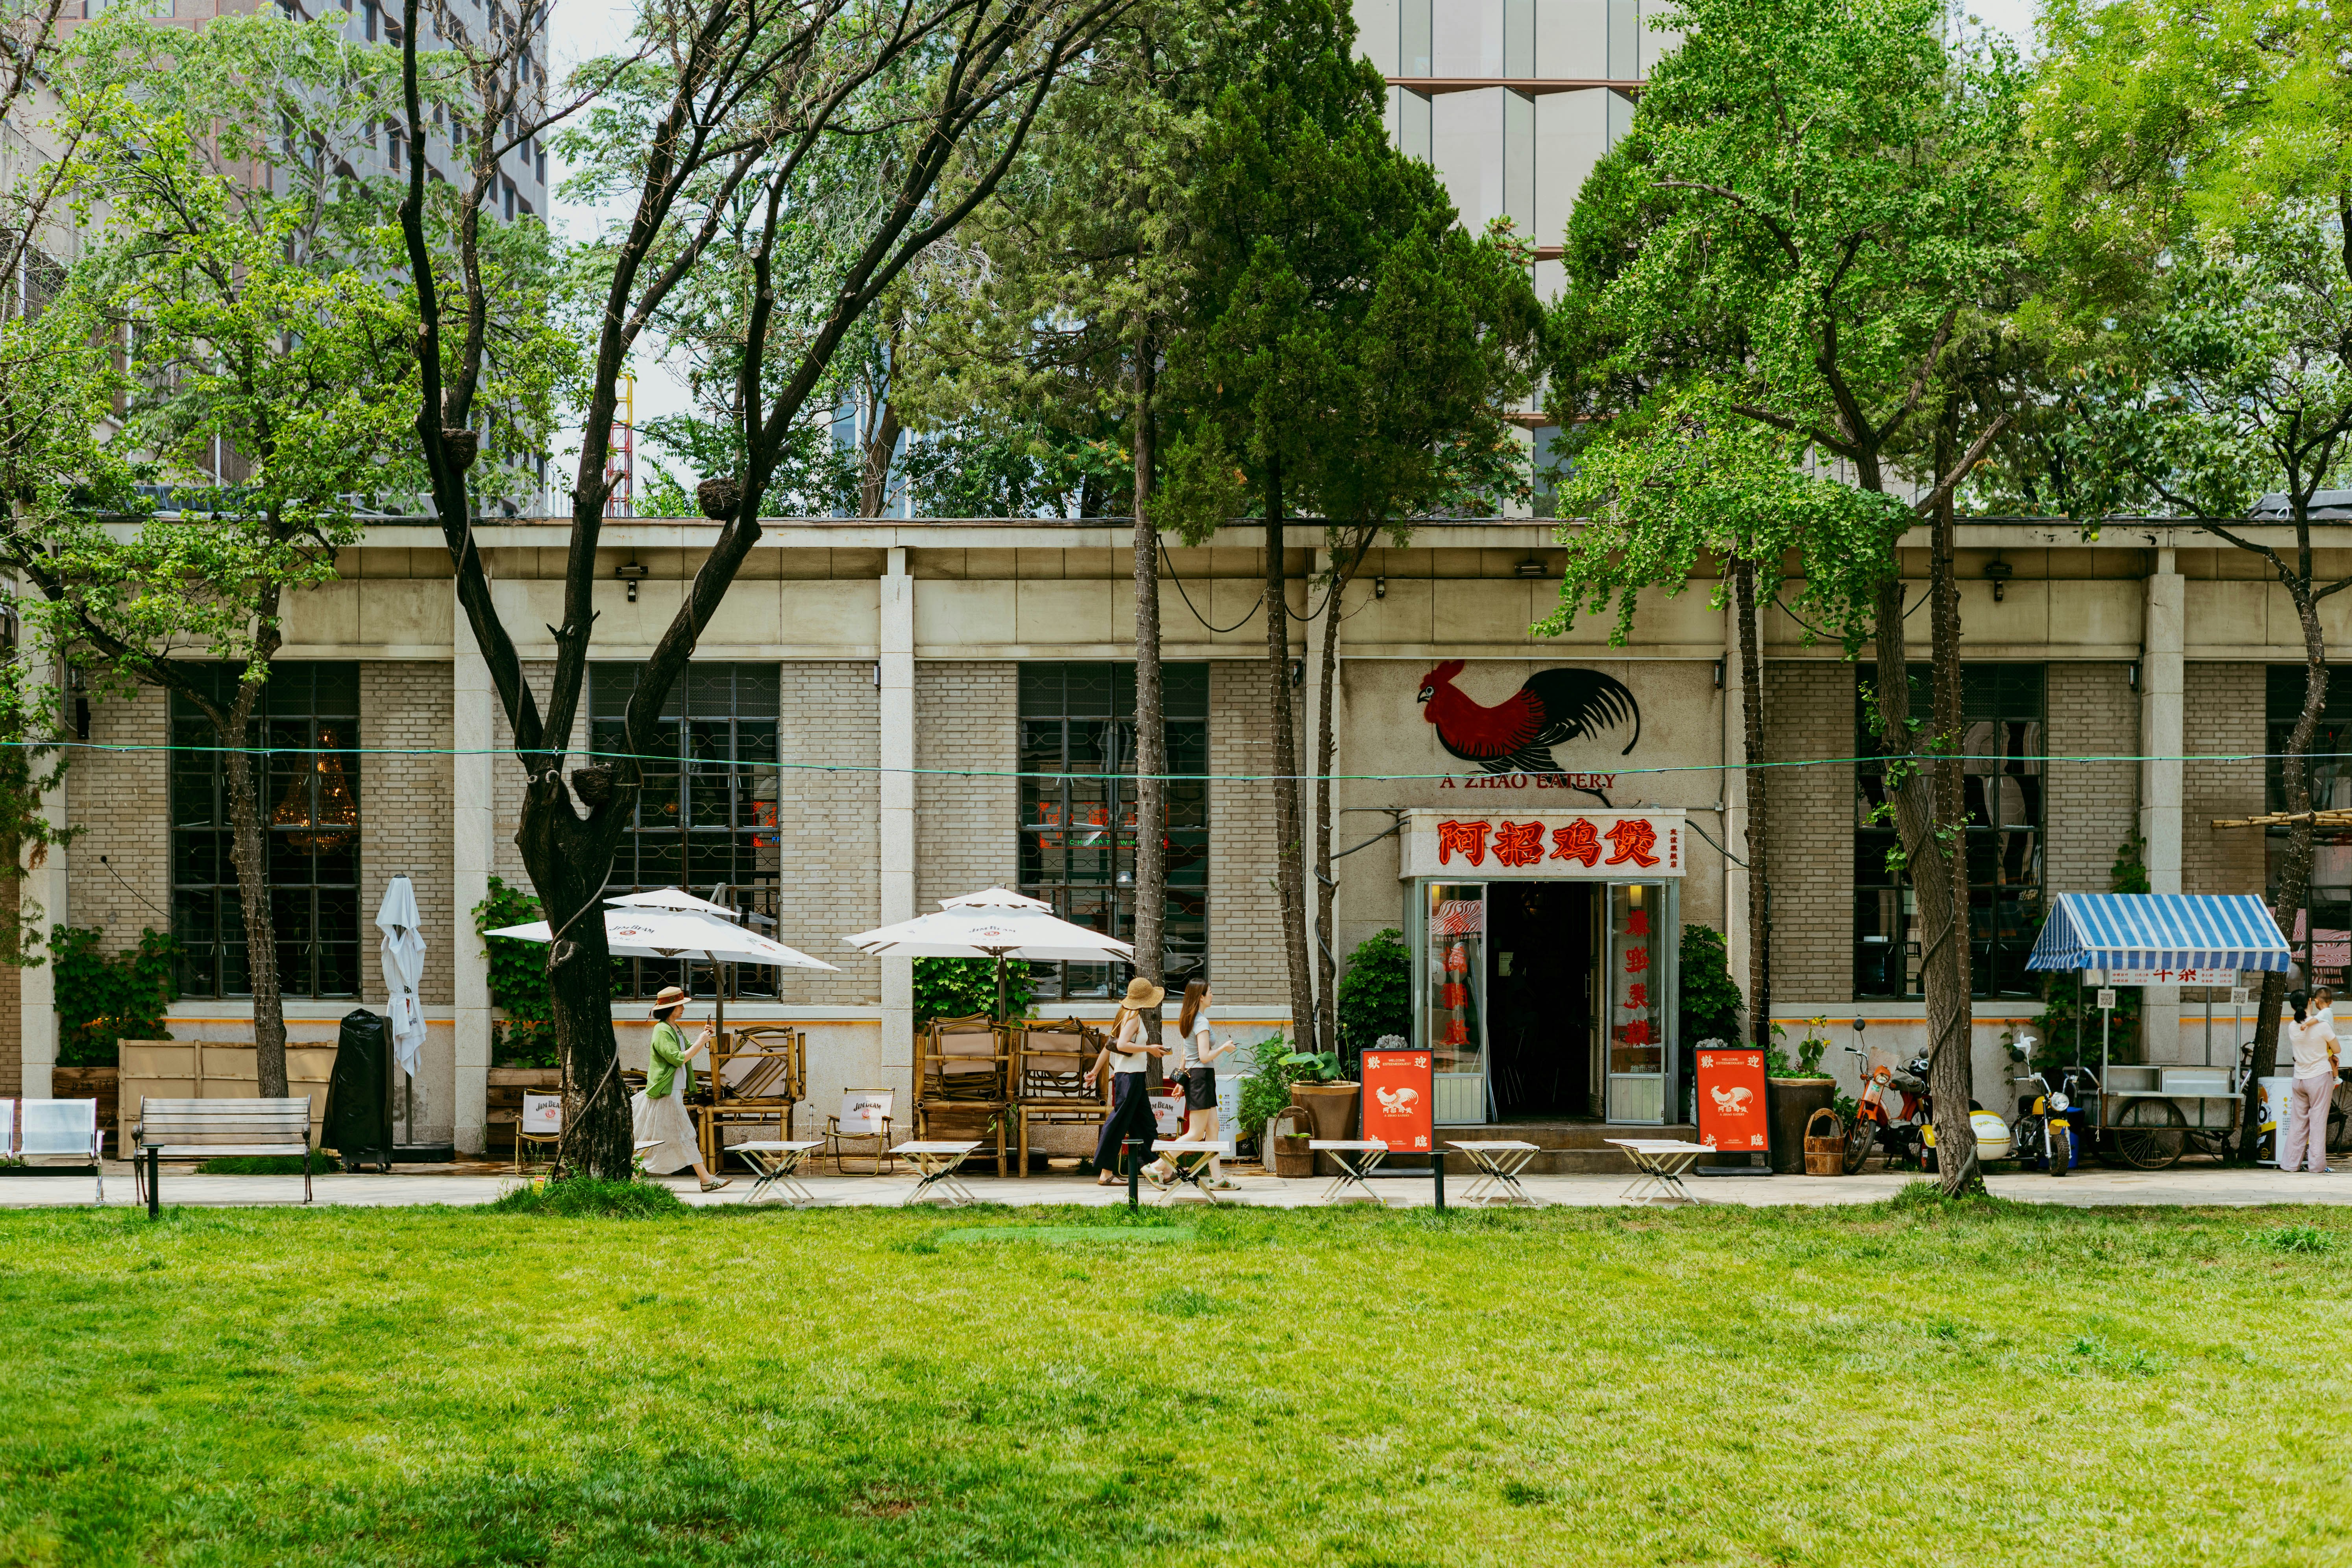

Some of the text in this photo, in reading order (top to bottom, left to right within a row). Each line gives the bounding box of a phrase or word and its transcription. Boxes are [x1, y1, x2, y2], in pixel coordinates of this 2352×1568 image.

[1440, 773, 1616, 788] A ZHAO EATERY
[1437, 818, 1660, 867] 阿招鸡煲
[631, 925, 655, 934] BEAM
[1366, 1056, 1380, 1069] 歡
[1414, 1056, 1427, 1068] 迎
[1701, 1055, 1714, 1068] 歡
[1747, 1055, 1760, 1068] 迎
[536, 1100, 560, 1111] JIM BEA
[853, 1100, 881, 1111] JIM BEAM
[1158, 1101, 1174, 1112] BEAM
[1415, 1135, 1427, 1147] 臨
[1703, 1133, 1717, 1147] 光
[1751, 1133, 1764, 1146] 臨
